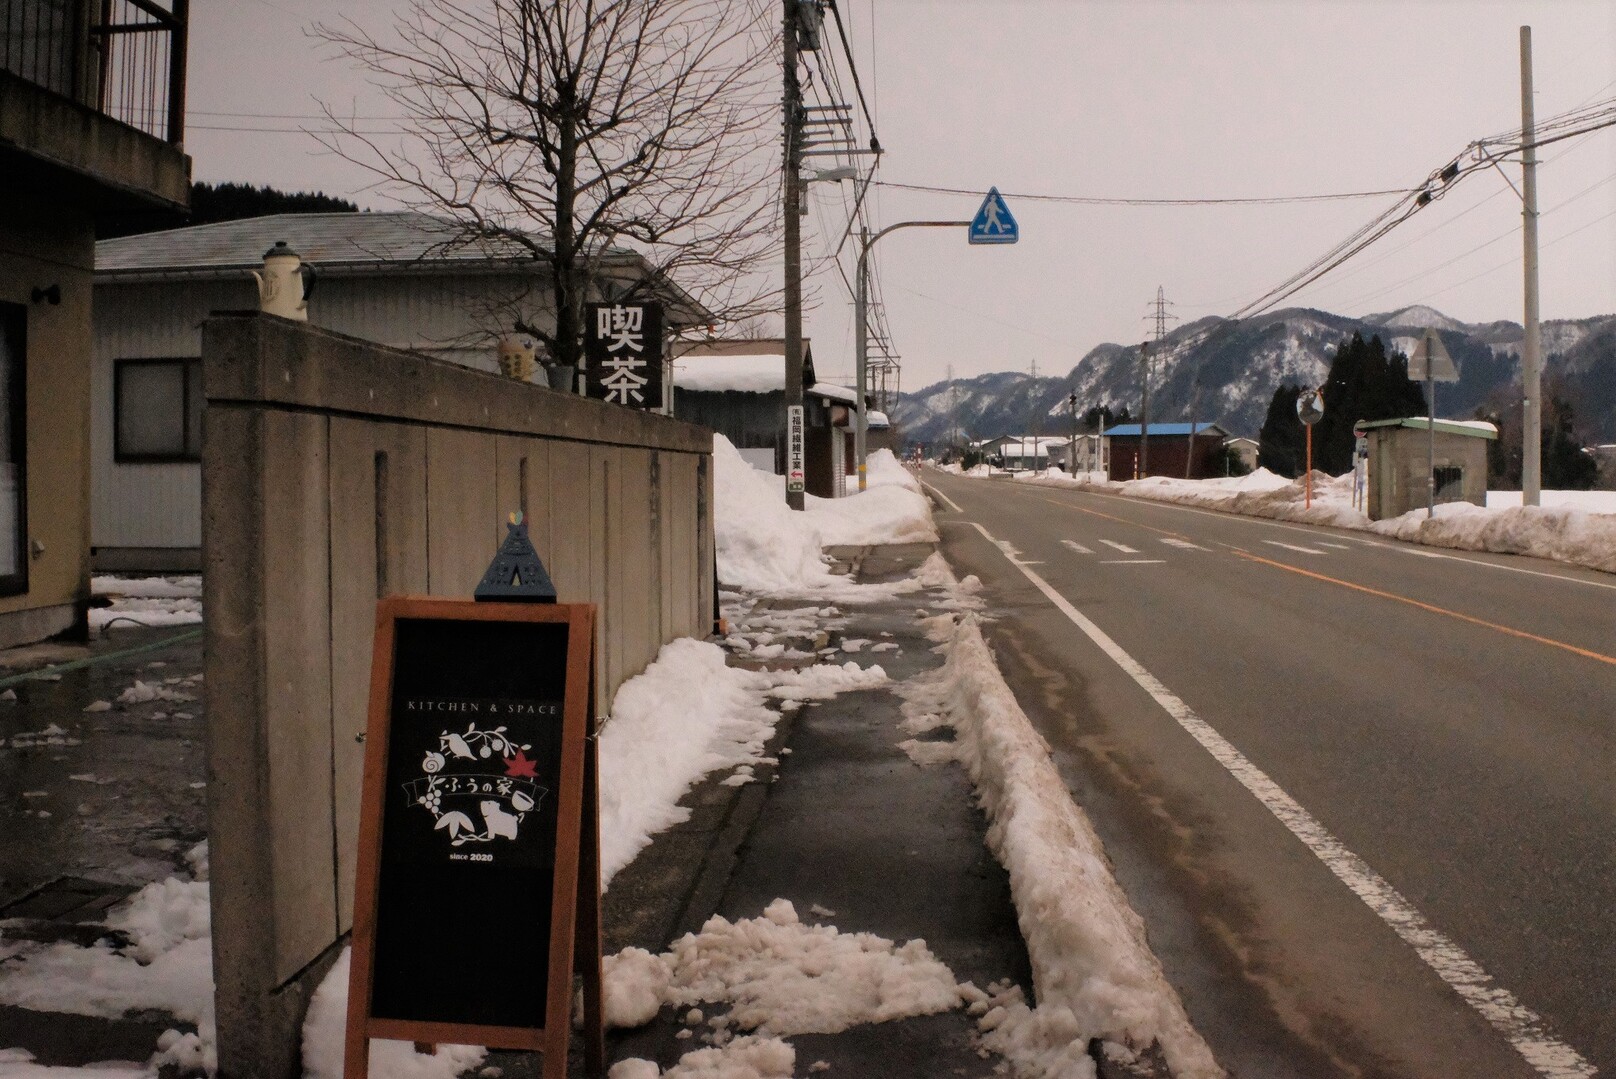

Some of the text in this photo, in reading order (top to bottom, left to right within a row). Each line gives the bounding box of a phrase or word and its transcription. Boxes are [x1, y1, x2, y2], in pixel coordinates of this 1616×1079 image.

[597, 304, 648, 404] 喫茶
[408, 701, 557, 714] KITCHEN & SPACE
[445, 777, 512, 796] ふうの家
[449, 853, 493, 862] since 2020
